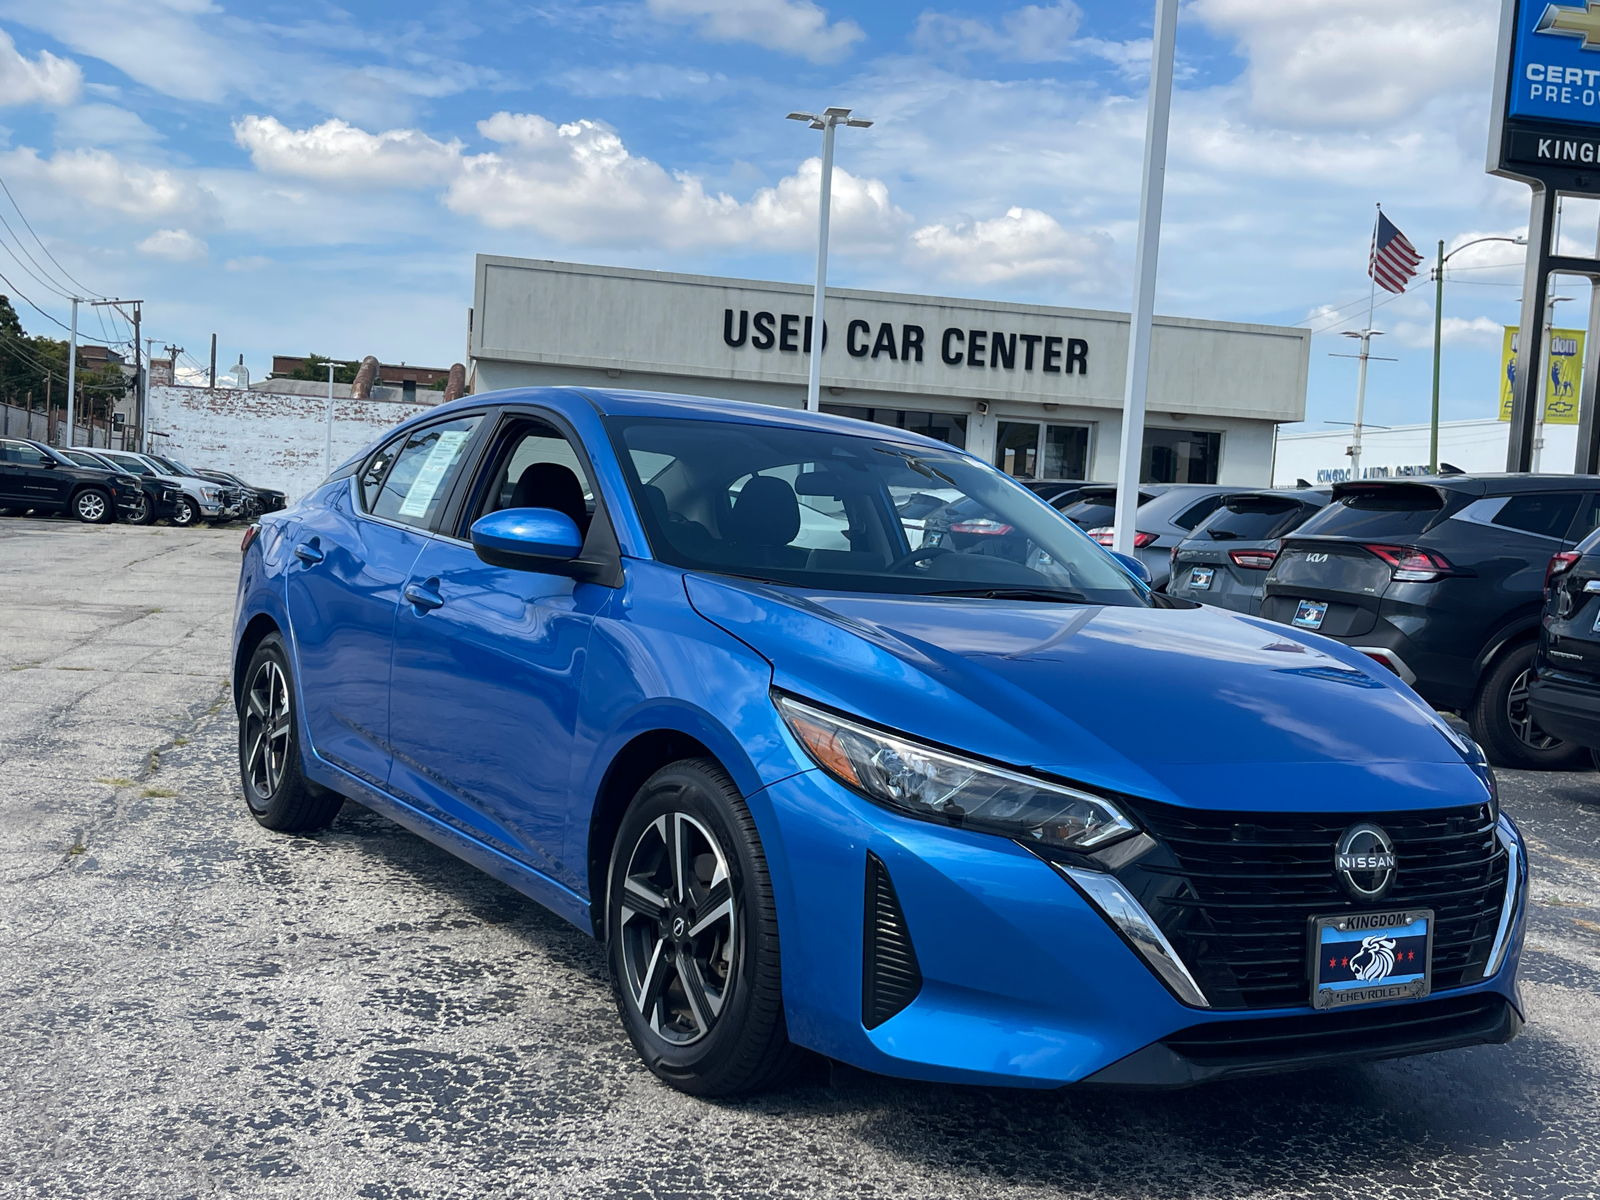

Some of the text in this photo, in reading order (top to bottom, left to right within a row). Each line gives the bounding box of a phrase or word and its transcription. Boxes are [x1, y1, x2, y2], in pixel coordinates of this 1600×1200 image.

[1526, 63, 1600, 87] CERT
[1530, 84, 1600, 106] PRE-O
[1537, 138, 1600, 164] KING
[846, 319, 925, 362] CAR
[941, 327, 1089, 375] CENTER
[1339, 856, 1395, 868] NISSAN
[1346, 913, 1407, 930] KINGDOM
